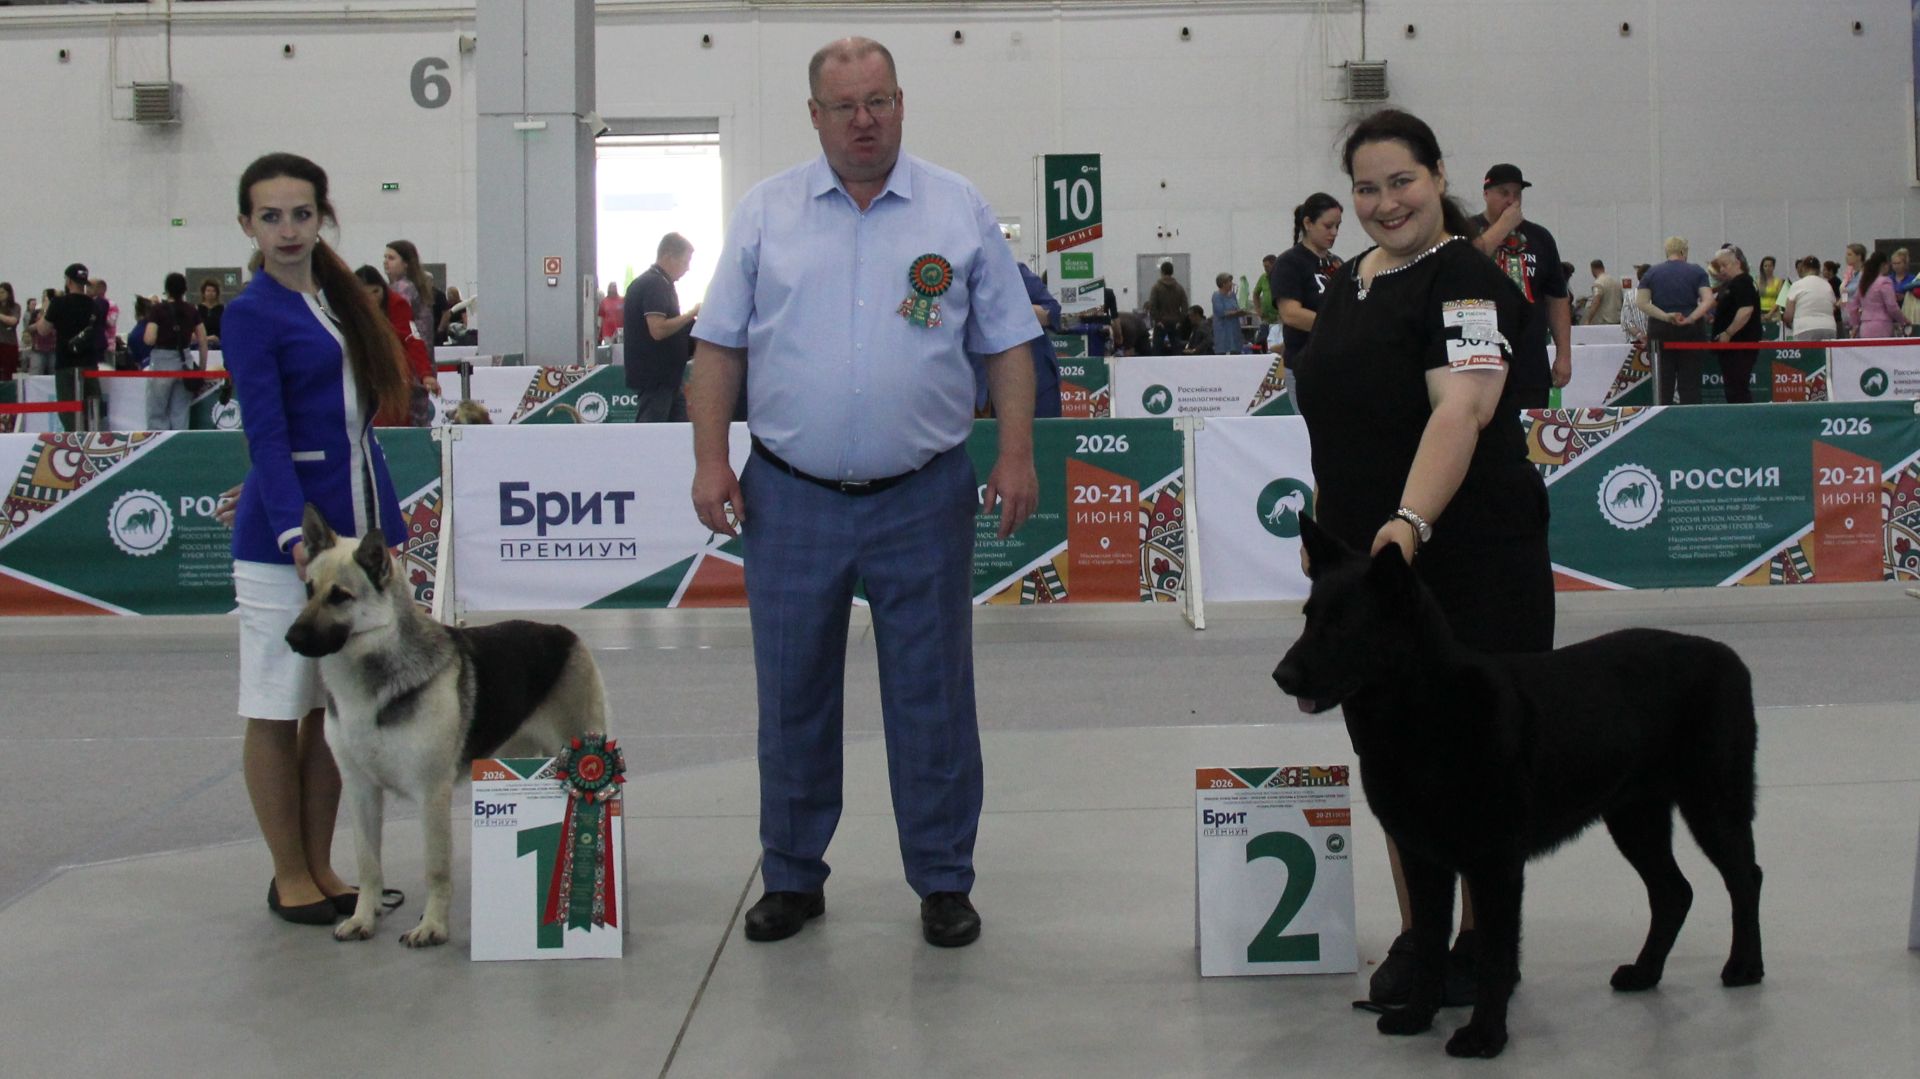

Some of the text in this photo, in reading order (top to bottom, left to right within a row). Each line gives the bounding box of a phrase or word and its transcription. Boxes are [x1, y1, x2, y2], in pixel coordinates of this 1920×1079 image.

[410, 57, 451, 109] 6
[1053, 179, 1094, 220] 10
[1060, 229, 1092, 245] РИНГ
[1776, 349, 1801, 359] 2026
[1059, 366, 1085, 376] 2026
[1775, 374, 1803, 383] 20-21
[612, 395, 639, 406] РОС
[1820, 417, 1873, 436] 2026
[1075, 434, 1130, 453] 2026
[1669, 466, 1780, 490] РОССИЯ
[1819, 466, 1875, 485] 20-21
[1073, 484, 1132, 504] 20-21
[1822, 491, 1875, 505] ИЮНЯ
[499, 481, 635, 536] Брит
[1077, 511, 1132, 524] ИЮНЯ
[500, 542, 636, 558] ПРЕМИУМ
[482, 771, 505, 780] 2026
[1210, 780, 1233, 788] 2026
[474, 800, 517, 818] Брит
[474, 819, 518, 827] ПРЕМИУМ
[1203, 809, 1247, 828] Брит
[1203, 828, 1248, 836] ПРЕМИУМ
[516, 822, 564, 949] 1
[1246, 831, 1320, 963] 2
